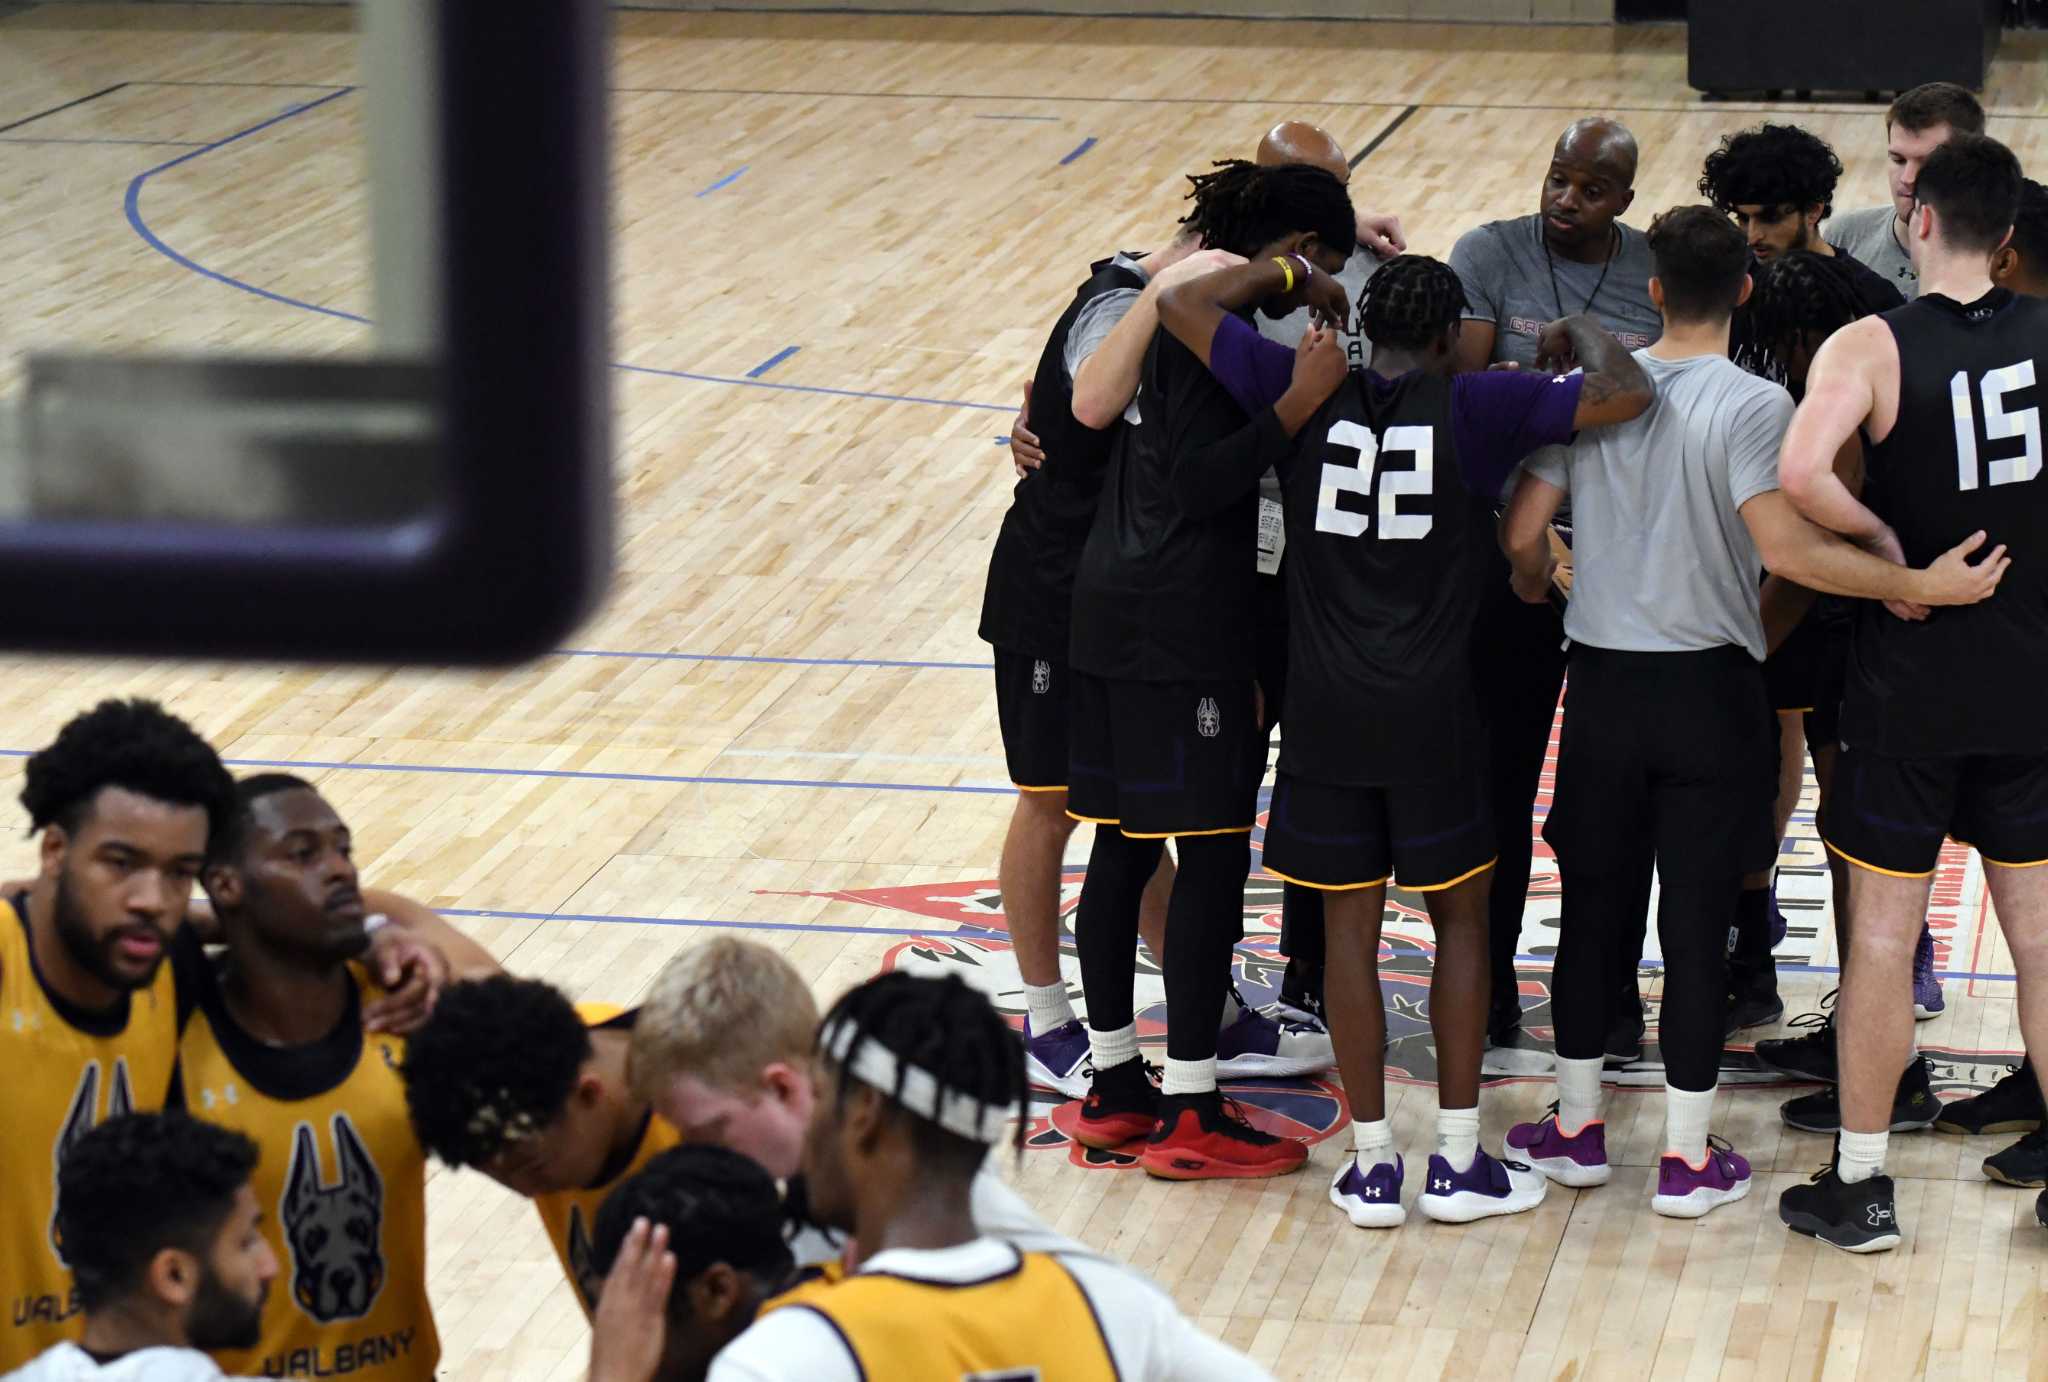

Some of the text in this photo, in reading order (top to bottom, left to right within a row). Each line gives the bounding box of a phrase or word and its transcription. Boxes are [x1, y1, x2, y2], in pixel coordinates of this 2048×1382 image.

[1315, 419, 1434, 540] 22
[1950, 358, 2043, 491] 15
[263, 1326, 416, 1378] UALBANY
